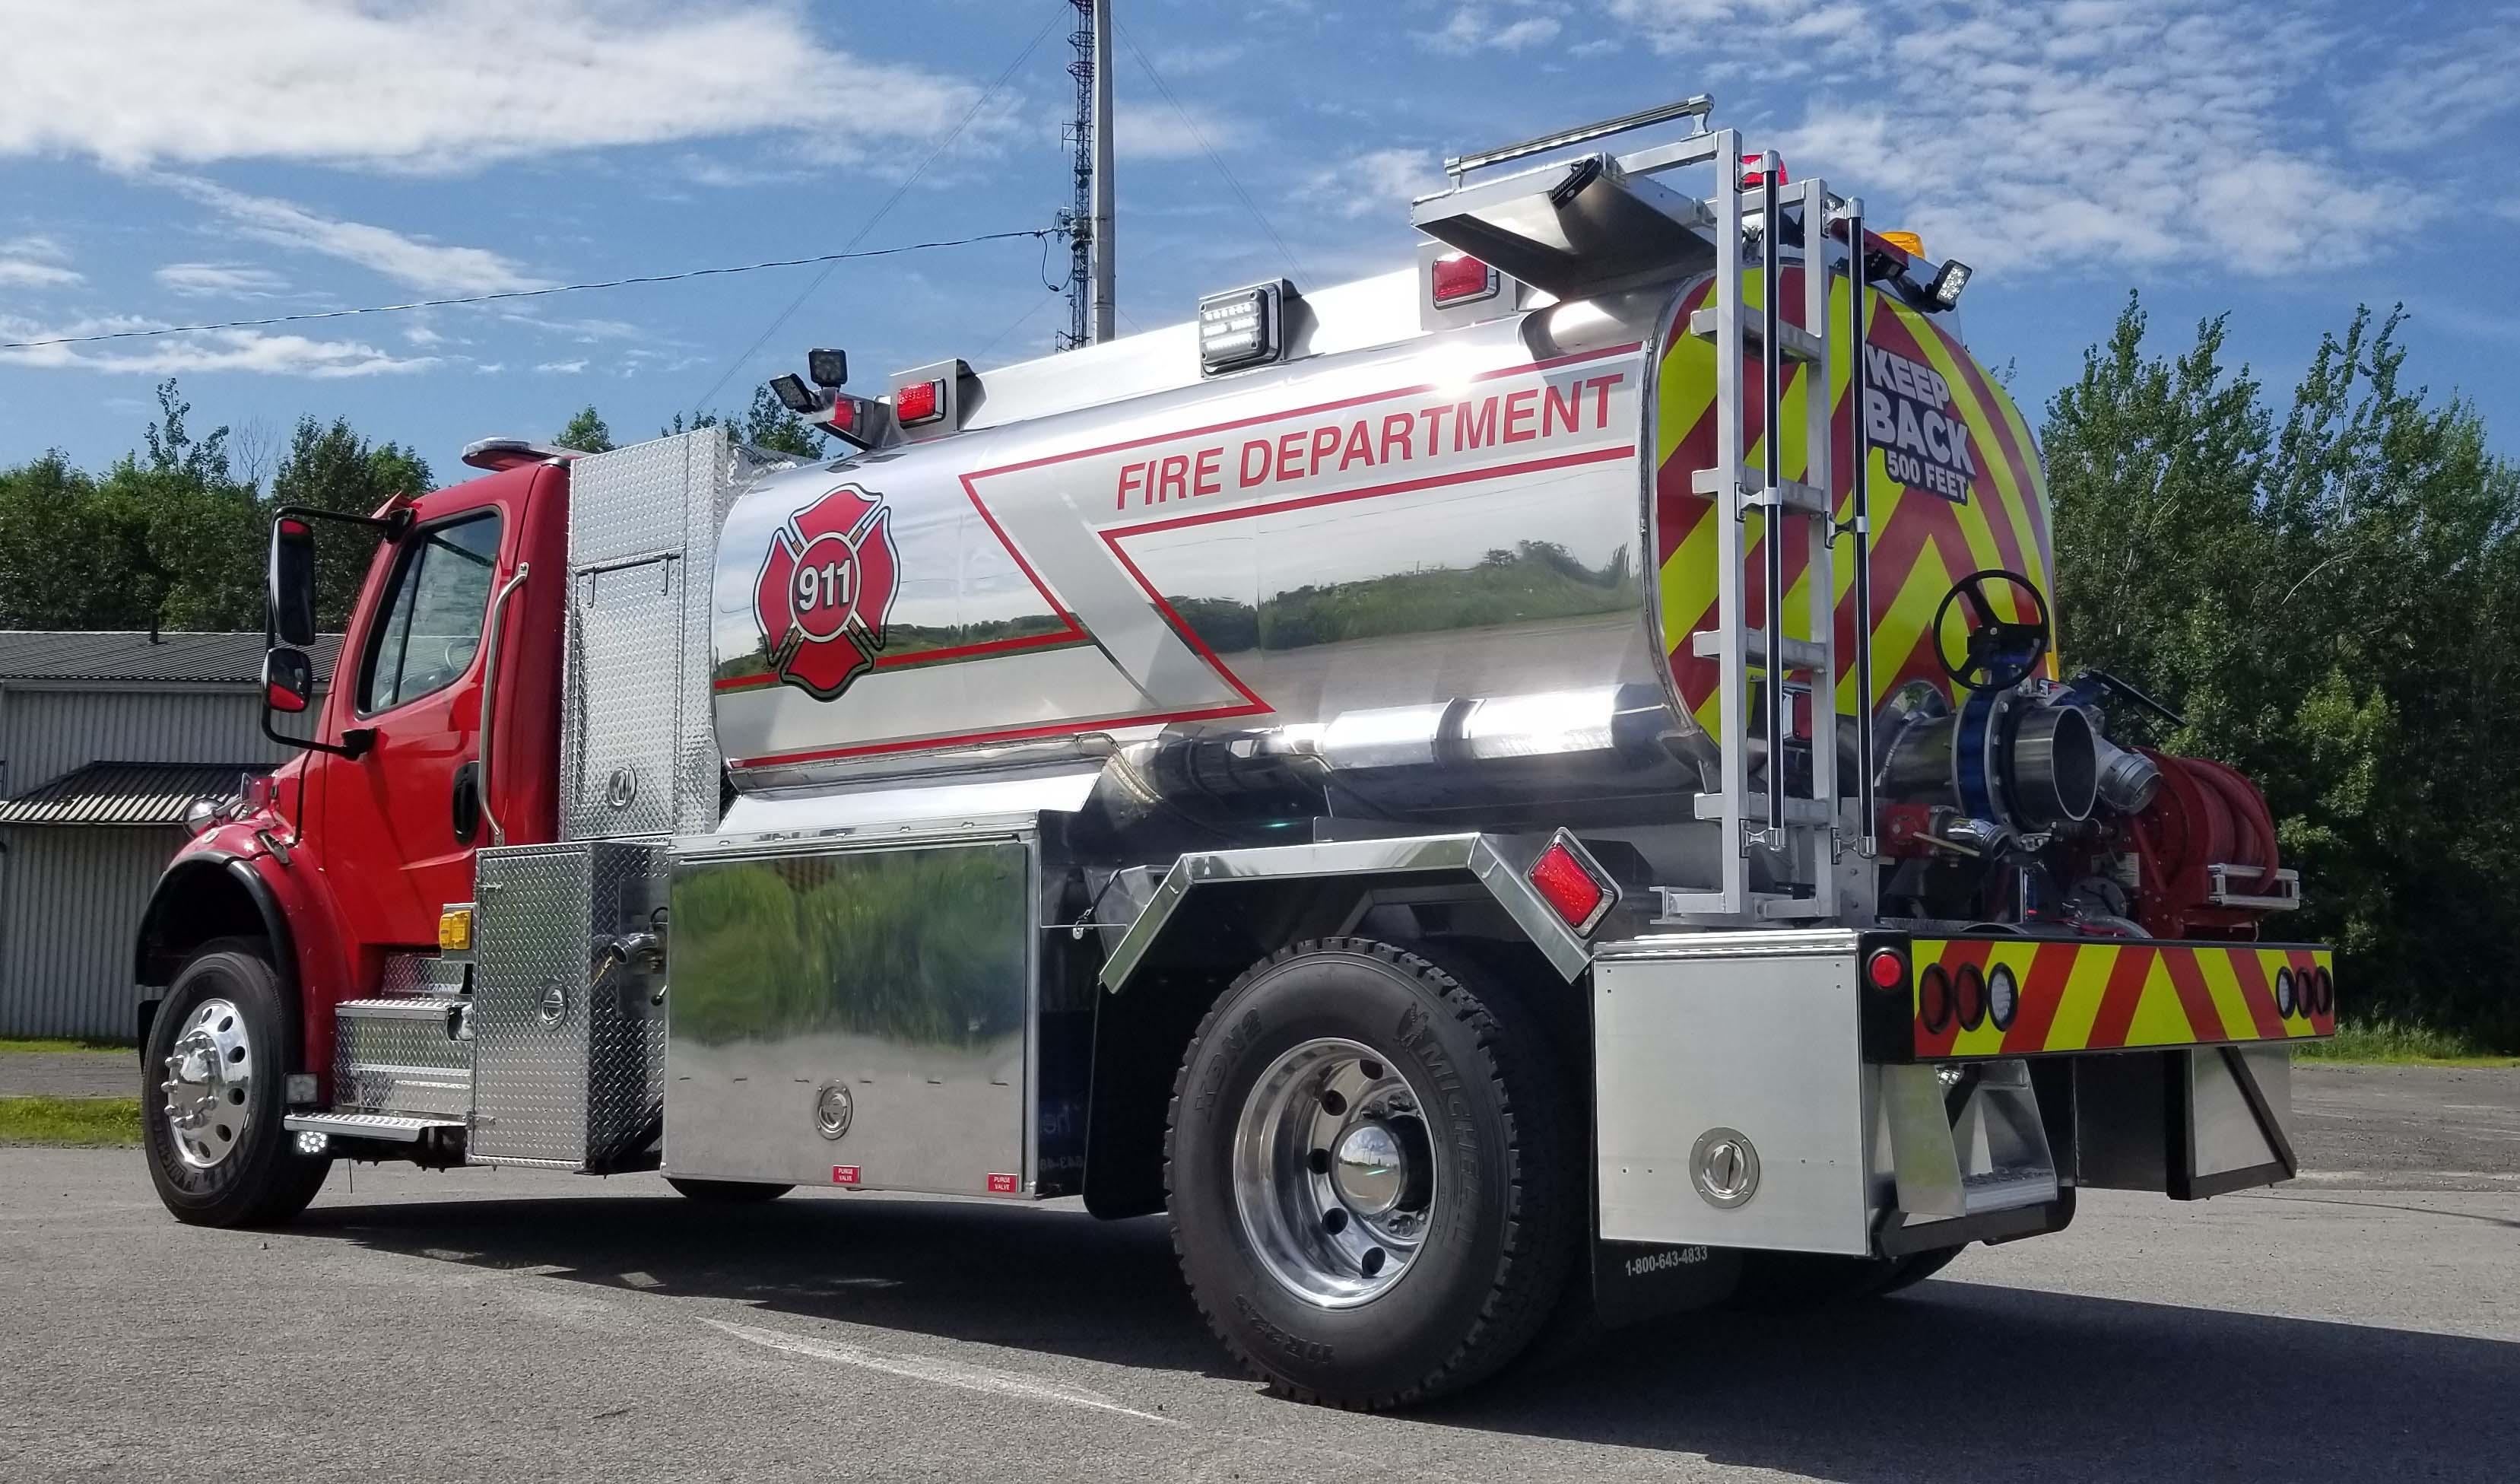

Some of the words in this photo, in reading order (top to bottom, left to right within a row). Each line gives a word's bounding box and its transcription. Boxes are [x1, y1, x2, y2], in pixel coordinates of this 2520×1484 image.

[1865, 344, 1950, 410] KEEP
[1117, 446, 1224, 510] FIRE
[1239, 373, 1624, 488] DEPARTMENT
[1865, 387, 1976, 475] BACK
[1887, 451, 1921, 484] 500
[1925, 462, 1968, 500] FEET
[798, 559, 852, 612] 911
[1625, 1245, 1709, 1276] 1-800-643-4833
